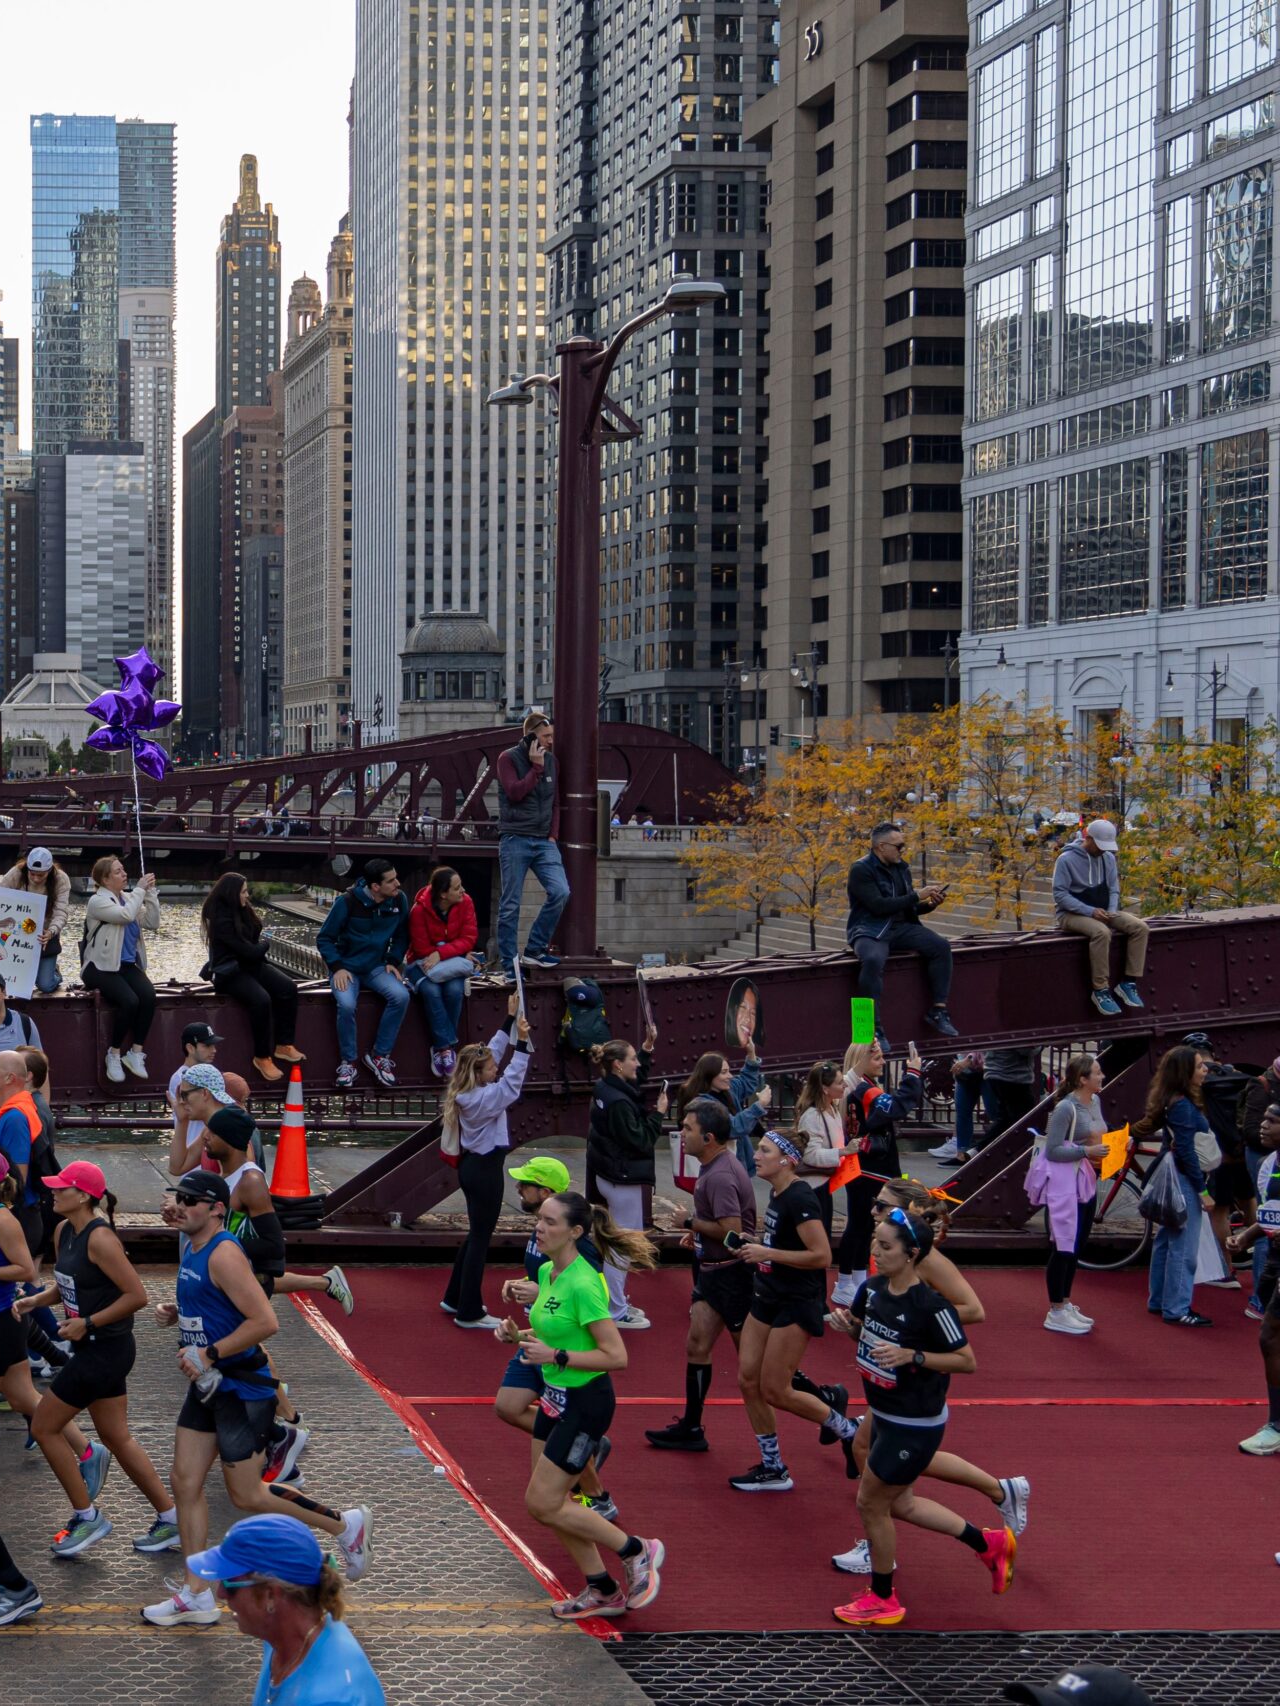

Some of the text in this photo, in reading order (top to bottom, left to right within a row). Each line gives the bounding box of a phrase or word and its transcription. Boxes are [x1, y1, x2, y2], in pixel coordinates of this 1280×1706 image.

[803, 20, 822, 61] 55
[11, 939, 34, 950] Makes
[12, 953, 25, 964] You
[864, 1315, 900, 1341] EATRIZ
